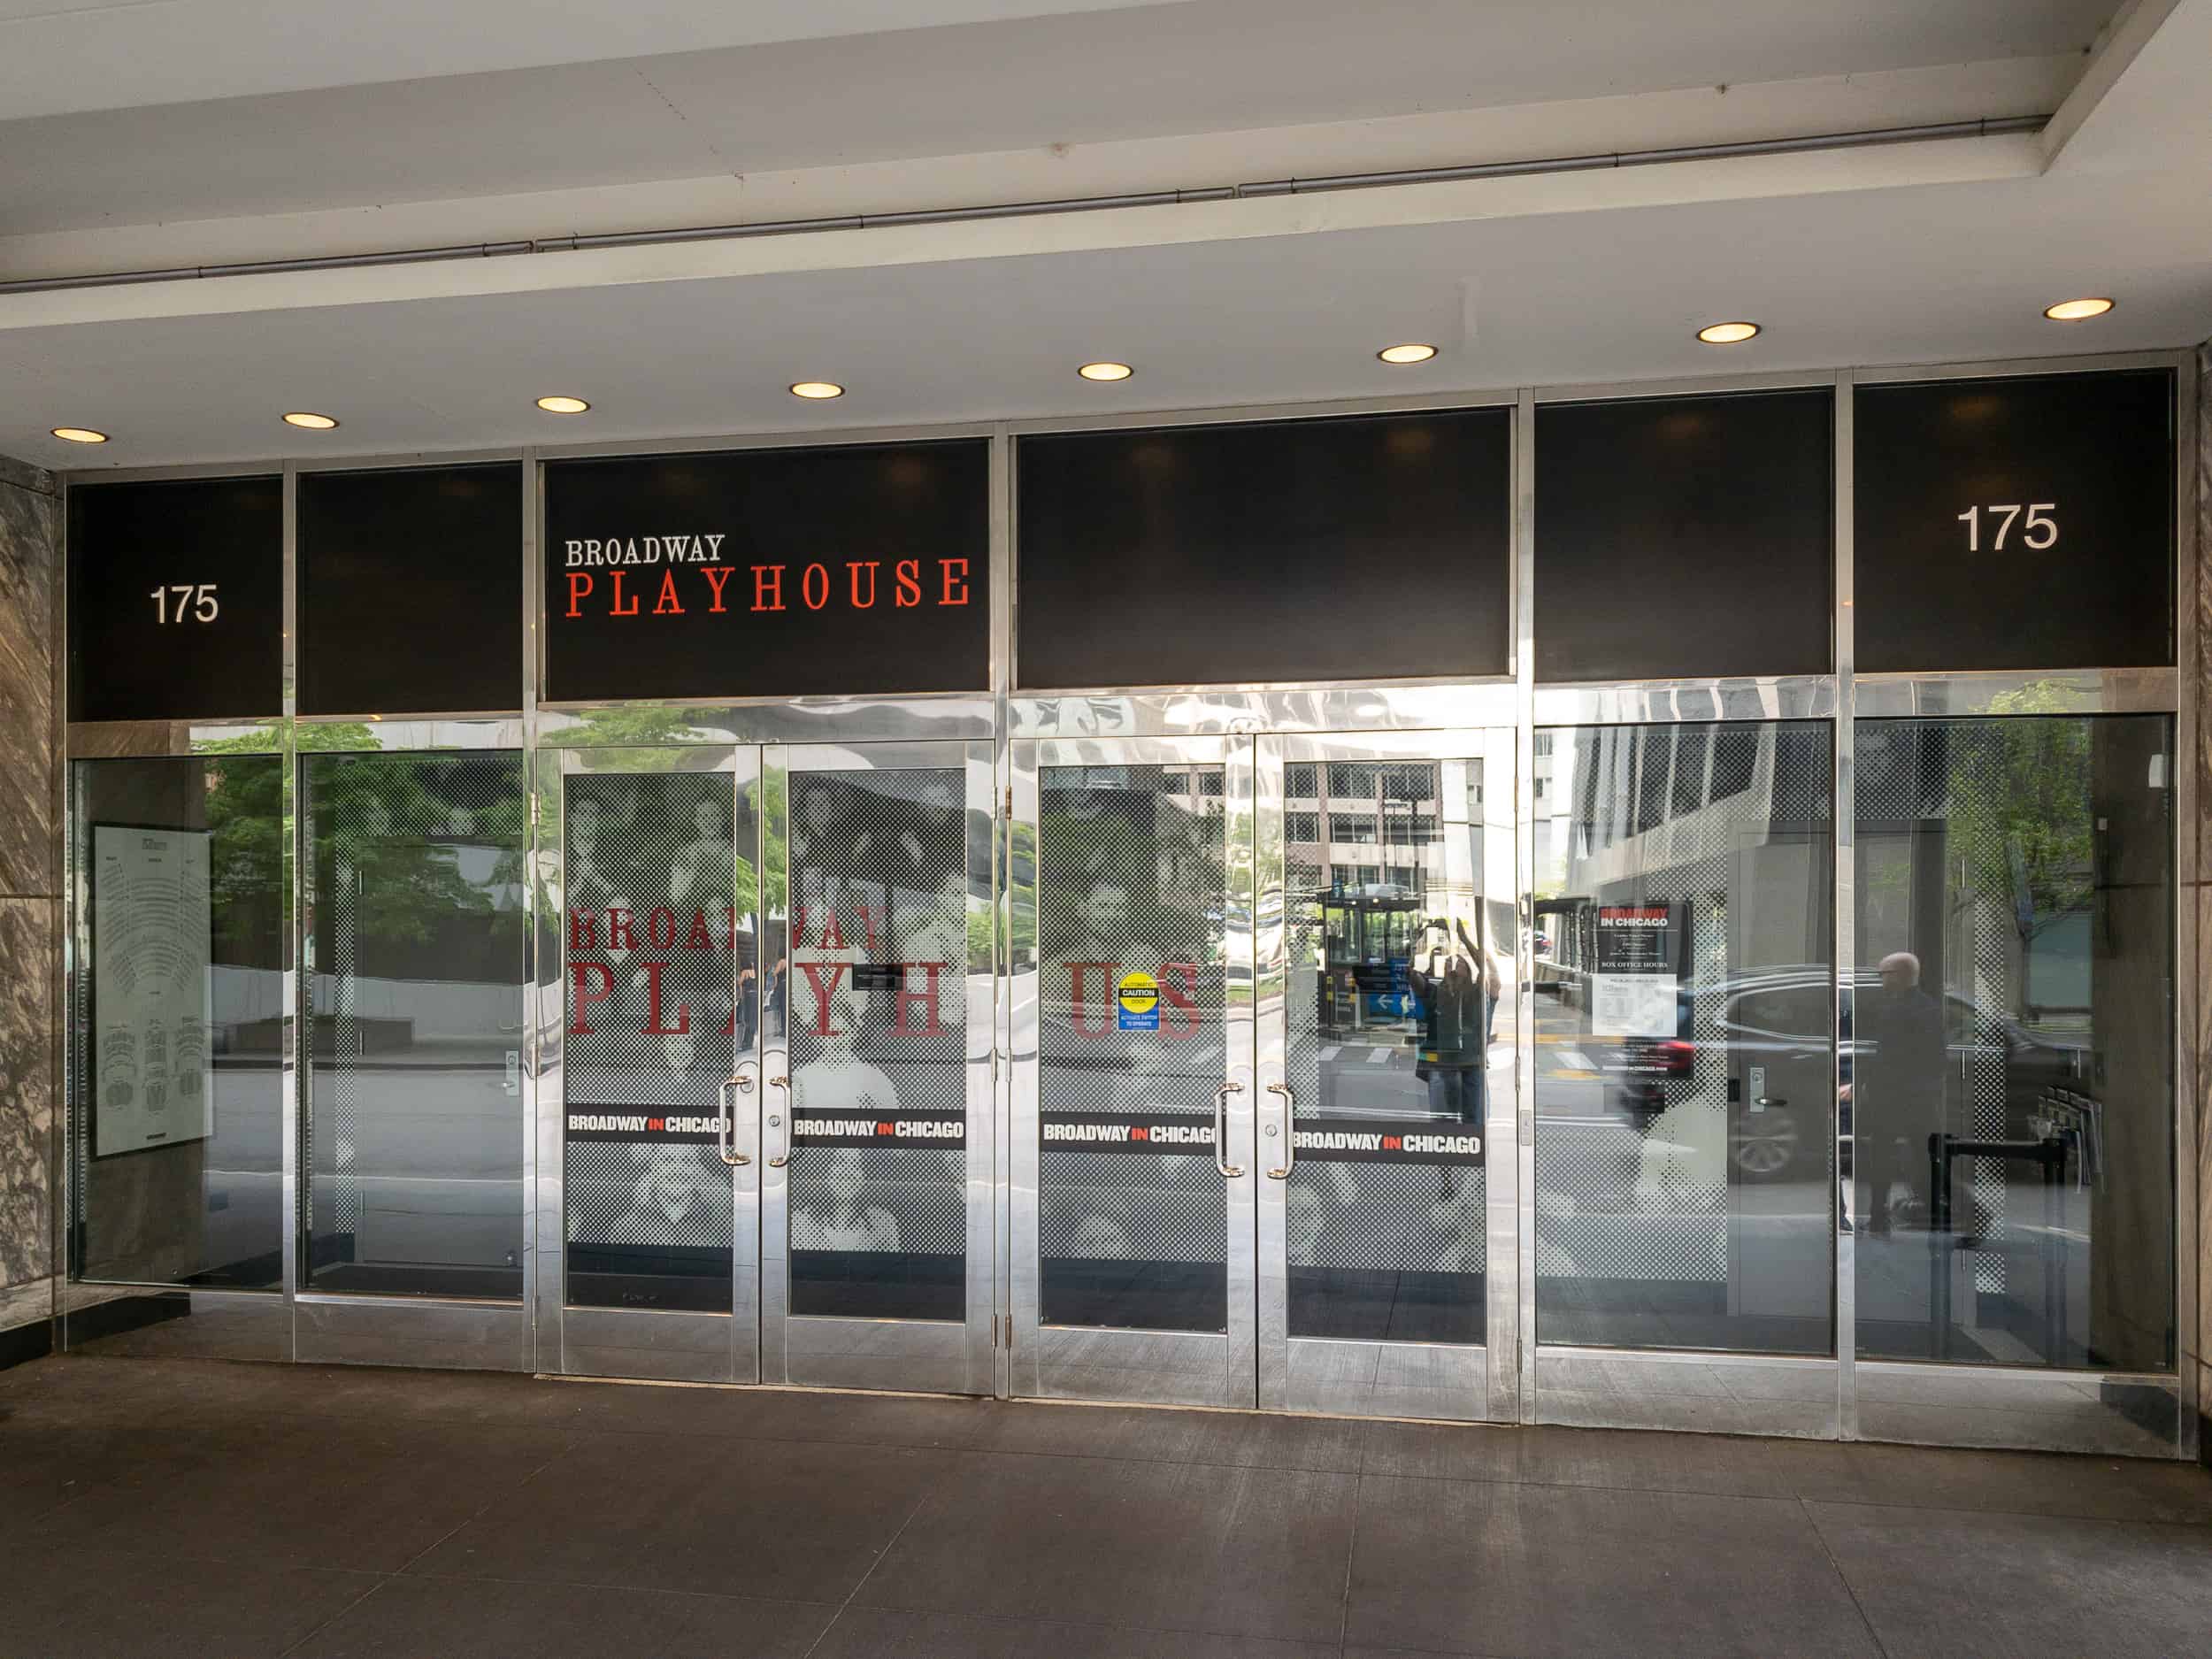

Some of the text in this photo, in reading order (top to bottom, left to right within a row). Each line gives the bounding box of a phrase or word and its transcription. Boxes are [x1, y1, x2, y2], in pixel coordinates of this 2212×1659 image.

[1958, 503, 2057, 551] 175
[565, 534, 725, 567] BROADWAY
[565, 558, 970, 617] PLAYHOUSE
[150, 585, 219, 623] 175
[1600, 907, 1669, 918] BROADWAY
[1615, 918, 1668, 926] CHICAGO
[568, 1115, 649, 1132] BROADWAY
[649, 1118, 664, 1131] IN
[795, 1119, 964, 1138] BROADWAY IN CHICAGO
[1043, 1124, 1131, 1141] BROADWAY
[1132, 1127, 1148, 1141] IN
[1293, 1132, 1480, 1154] BROADWAY IN CHICAGO
